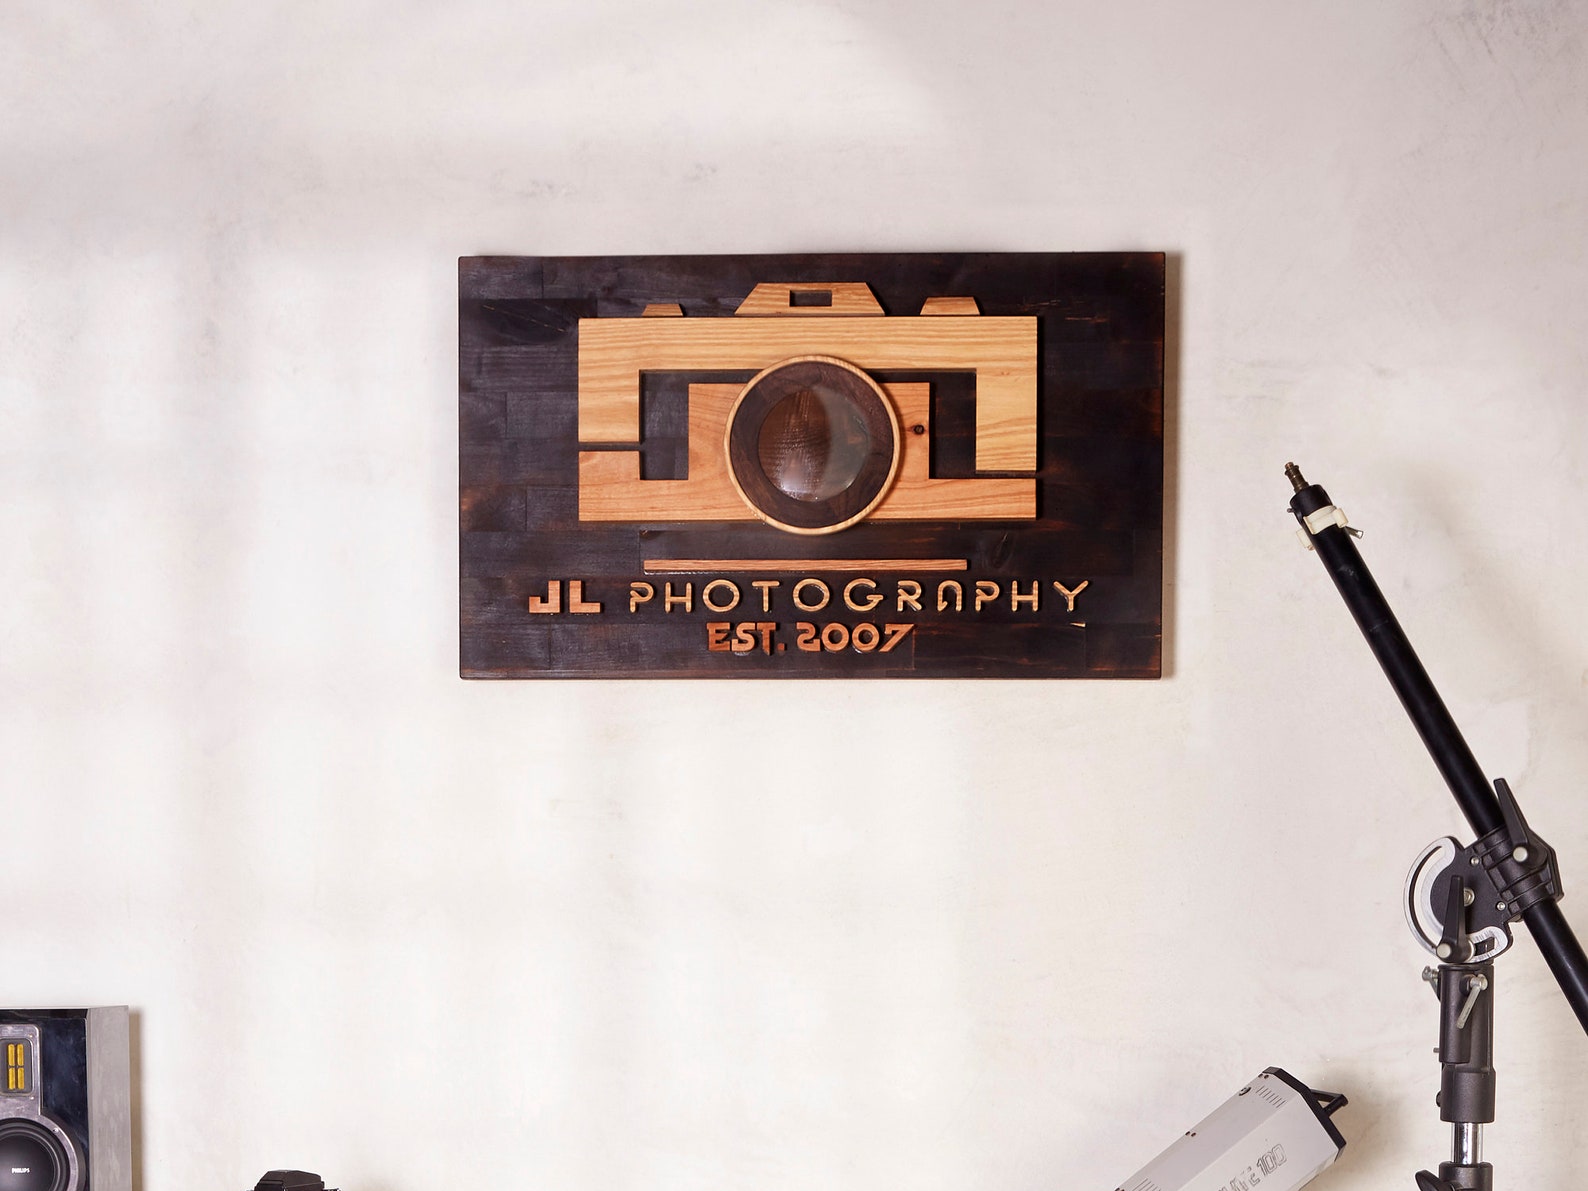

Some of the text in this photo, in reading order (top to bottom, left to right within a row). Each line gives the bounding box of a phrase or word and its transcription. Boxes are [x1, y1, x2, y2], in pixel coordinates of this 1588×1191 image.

[528, 578, 1089, 614] JL PHOTOGRAPHY
[706, 622, 914, 655] EST. 2007
[1256, 1143, 1287, 1177] 100
